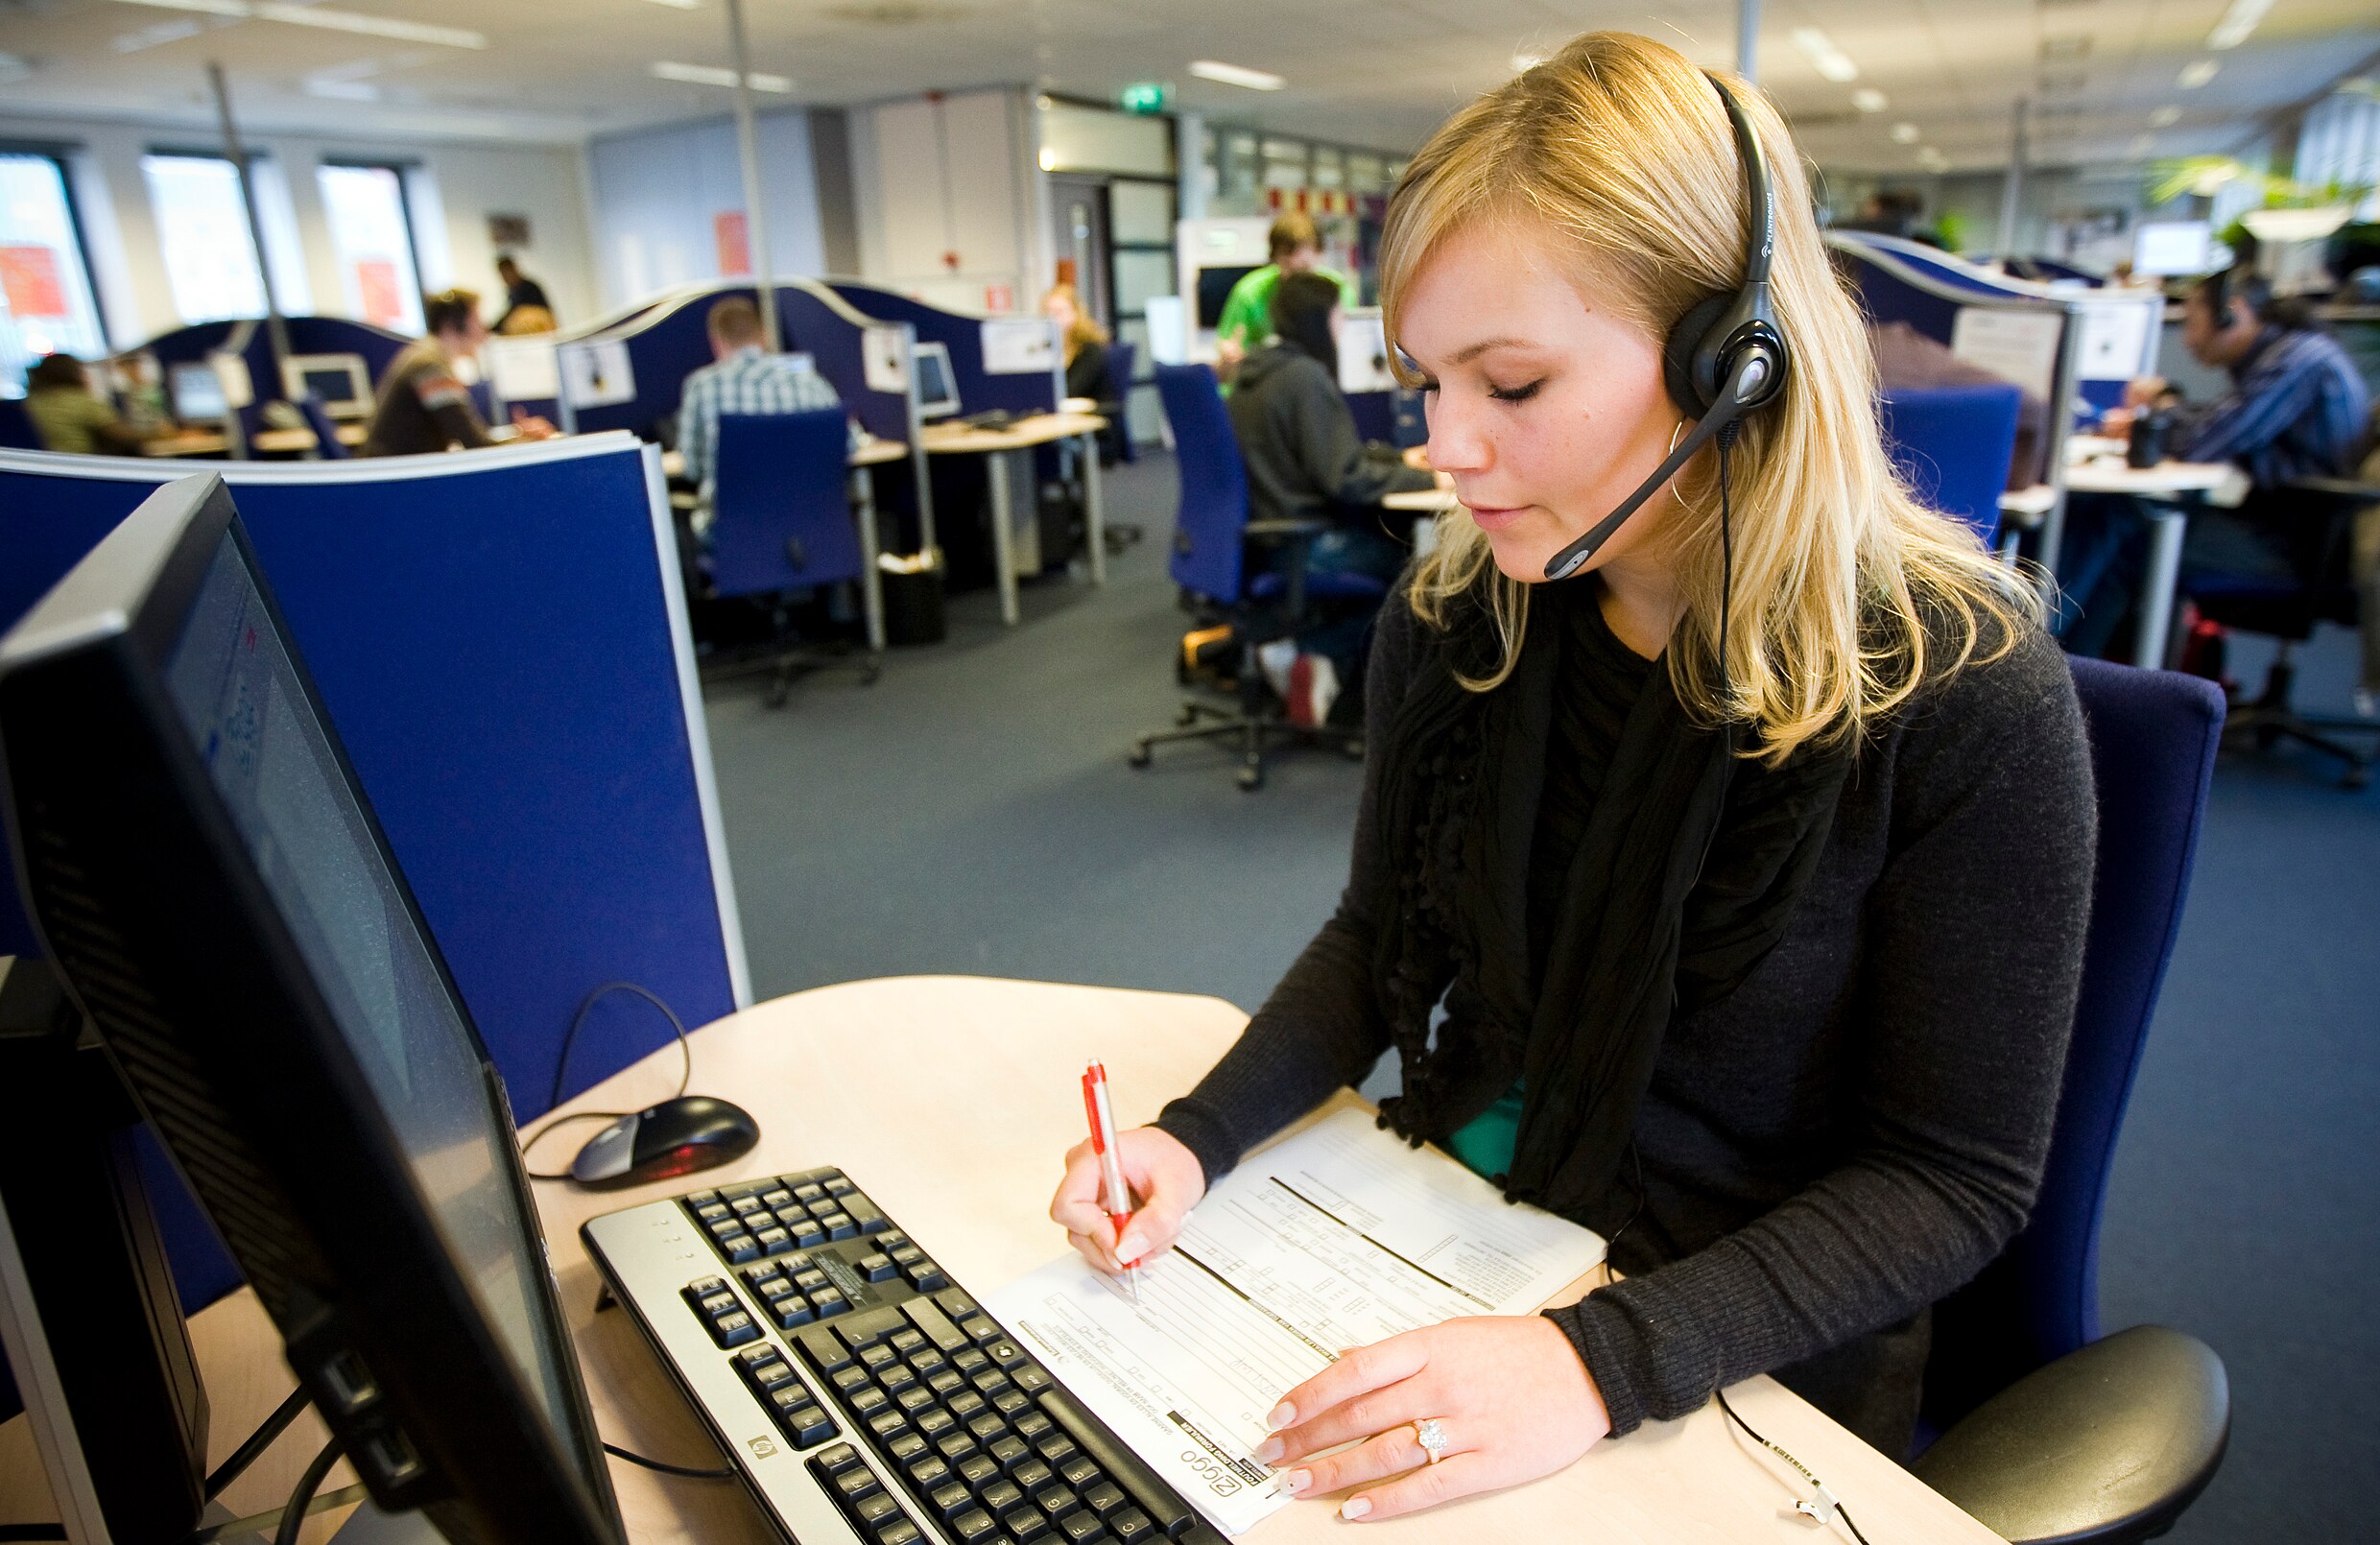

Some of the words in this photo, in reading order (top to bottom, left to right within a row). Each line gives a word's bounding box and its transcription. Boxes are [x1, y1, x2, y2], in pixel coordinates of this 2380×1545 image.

[1180, 1422, 1217, 1451] FORMULIER
[1214, 1447, 1259, 1486] FOUTMELDING
[1023, 1473, 1036, 1484] H
[1180, 1451, 1241, 1496] Ziggo
[1048, 1499, 1060, 1509] G
[872, 1507, 883, 1515] F6
[1123, 1523, 1134, 1532] C
[894, 1533, 905, 1543] F5
